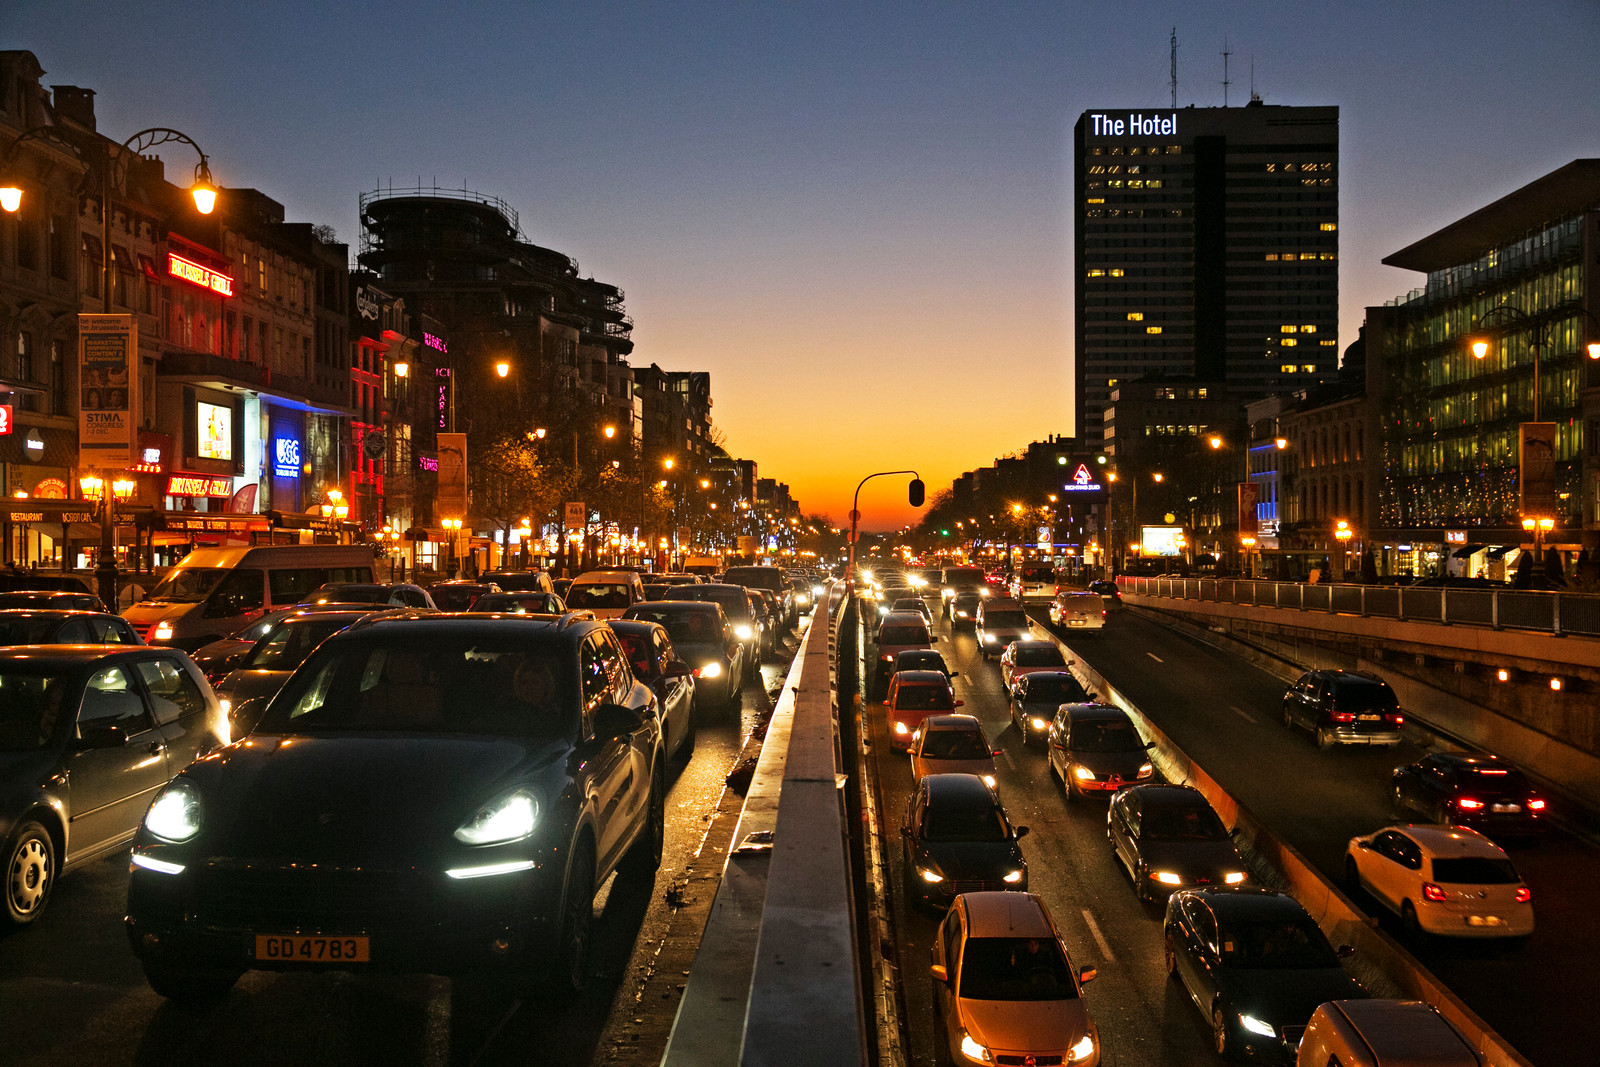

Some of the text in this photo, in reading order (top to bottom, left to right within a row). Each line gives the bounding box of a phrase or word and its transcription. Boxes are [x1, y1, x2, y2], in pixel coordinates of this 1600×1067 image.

[1090, 113, 1177, 136] The Hotel
[171, 257, 233, 297] BRUSSELS GRILL
[169, 477, 231, 496] BRUSSELS GRILL
[10, 512, 43, 522] RESTAURANT
[266, 938, 294, 958] GD
[299, 939, 357, 959] 4783
